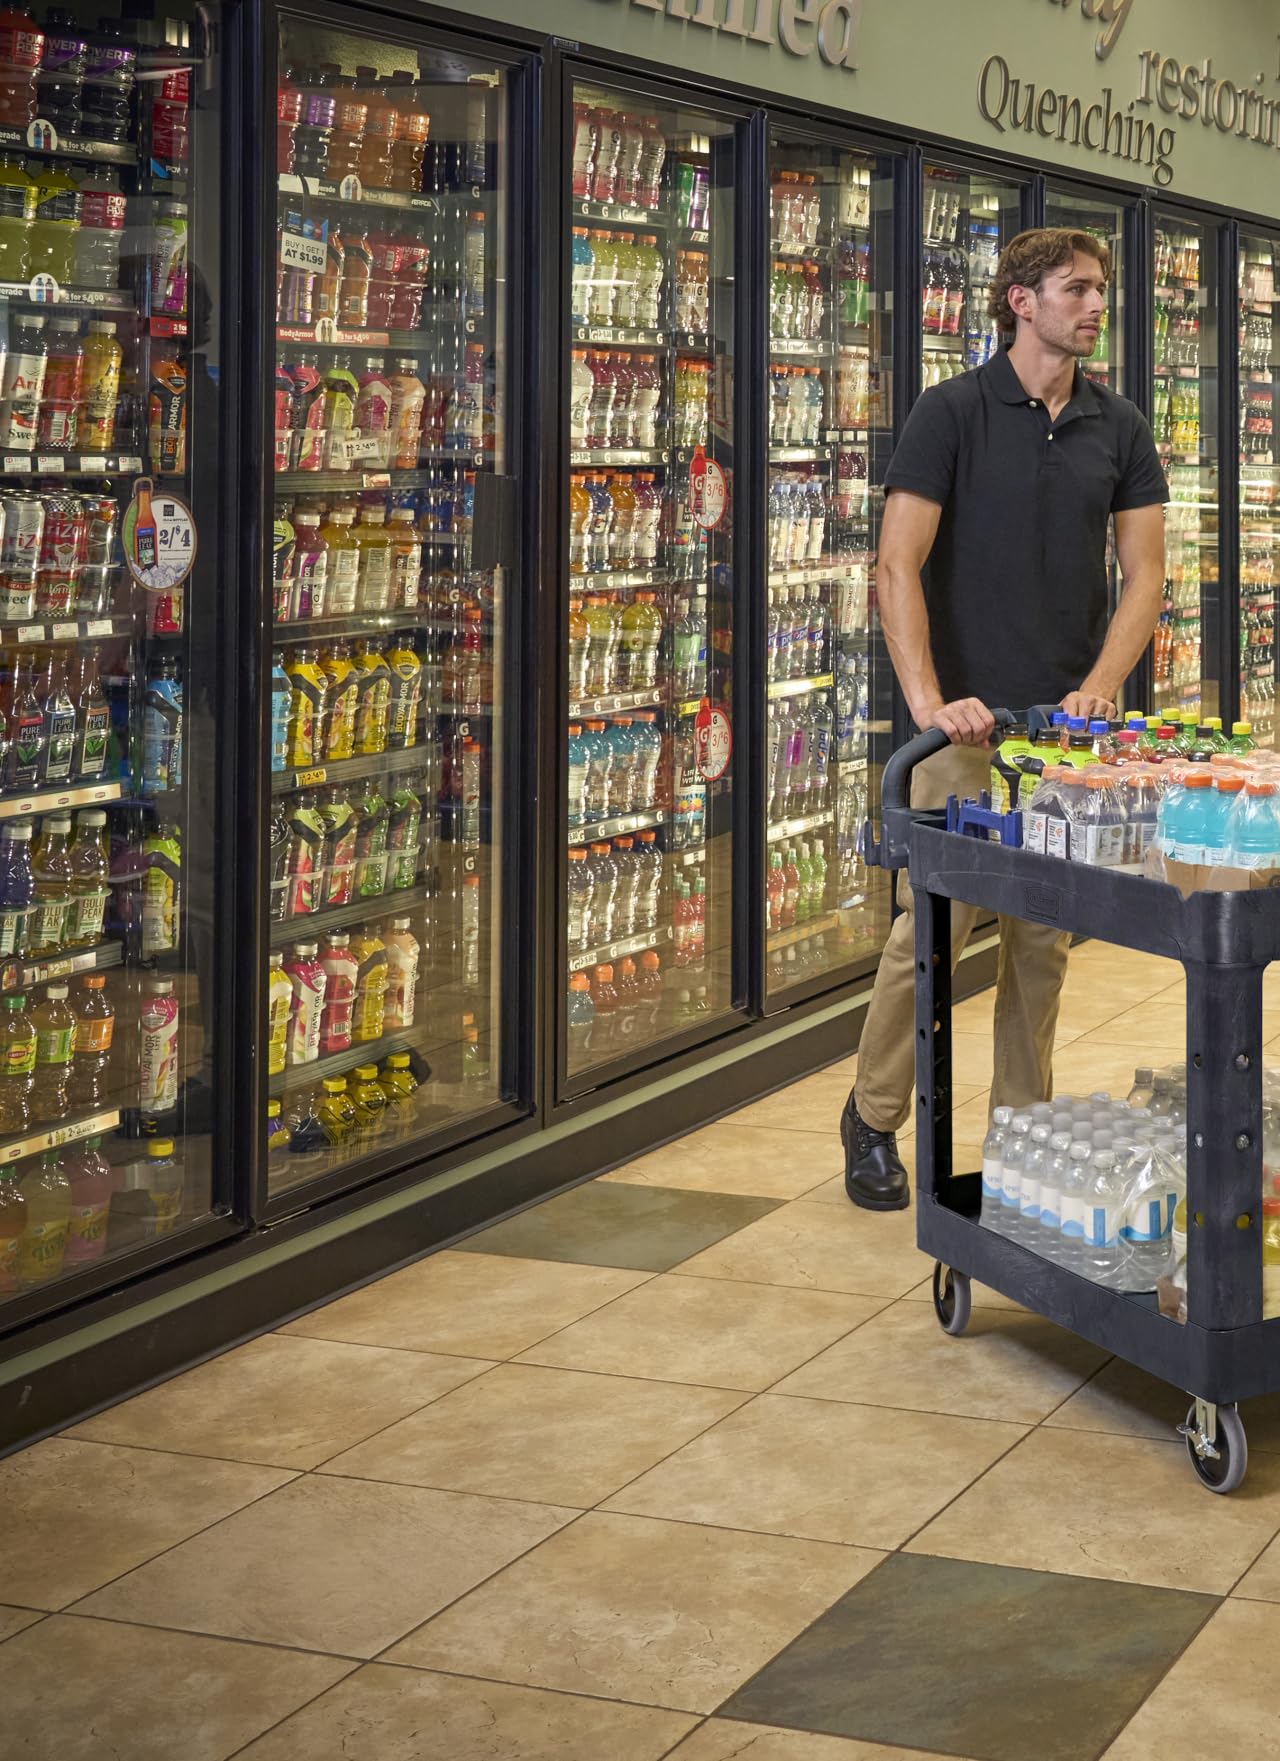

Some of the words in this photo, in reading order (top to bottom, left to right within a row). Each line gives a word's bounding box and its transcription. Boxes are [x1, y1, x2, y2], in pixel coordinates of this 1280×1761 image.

[87, 47, 123, 60] OWER
[978, 54, 1176, 185] Quenching
[0, 131, 21, 141] erade
[285, 240, 299, 249] BUY
[306, 245, 320, 254] GET
[285, 249, 298, 258] AT
[299, 252, 324, 266] $1.99
[0, 287, 23, 297] erade
[279, 329, 314, 338] BodyArmor
[8, 428, 36, 441] Swee
[21, 725, 41, 735] PURE
